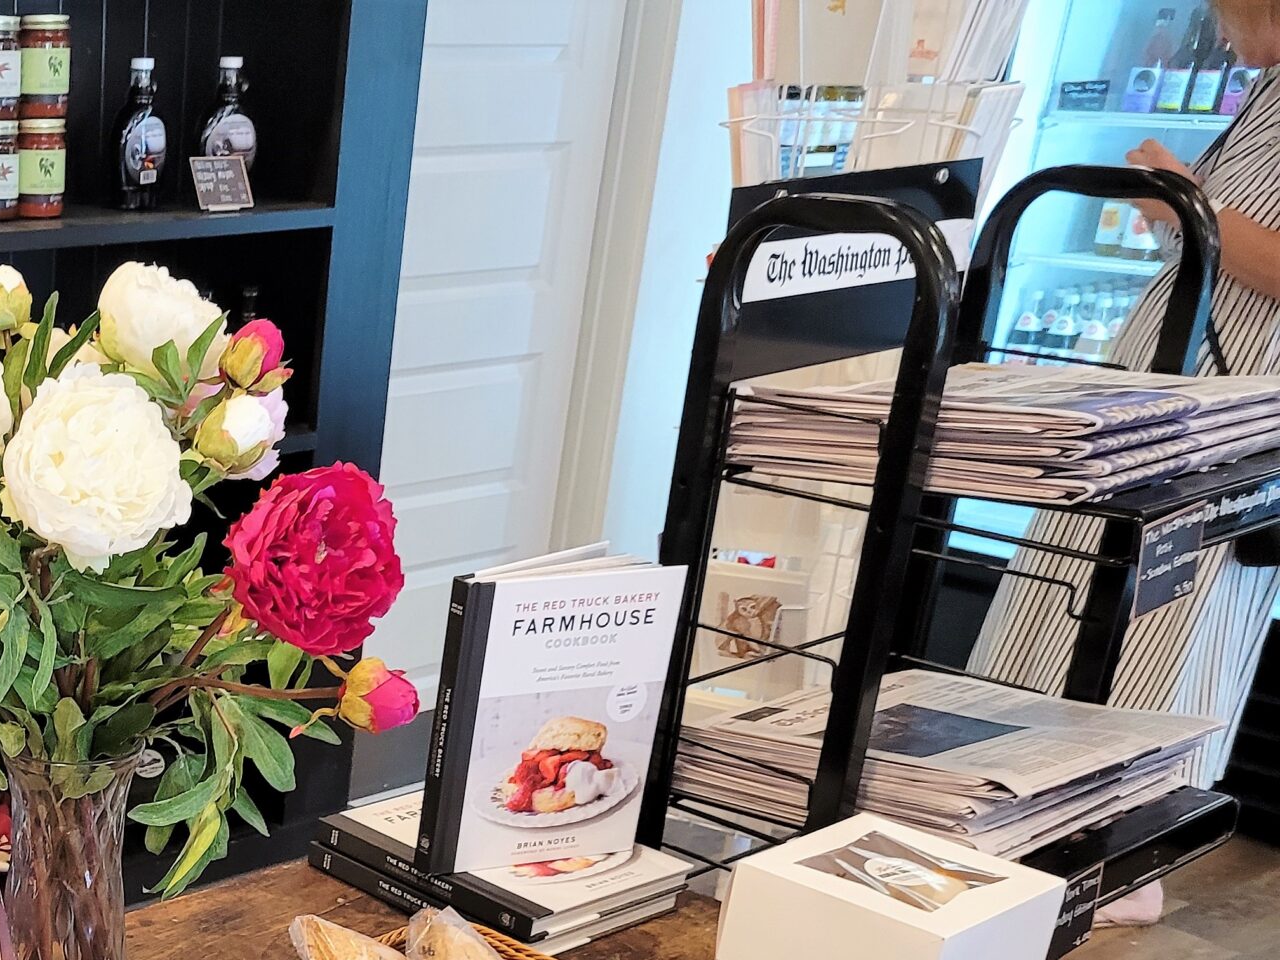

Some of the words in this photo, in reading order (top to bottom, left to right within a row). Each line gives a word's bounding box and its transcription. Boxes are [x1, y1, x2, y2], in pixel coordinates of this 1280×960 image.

[766, 251, 796, 288] The
[801, 242, 892, 281] Washington
[515, 602, 539, 613] THE
[542, 600, 567, 610] RED
[571, 597, 610, 608] TRUCK
[614, 592, 661, 605] BAKERY
[512, 608, 657, 636] FARMHOUSE
[545, 633, 618, 649] COOKBOOK
[516, 840, 544, 850] BRIAN
[547, 836, 576, 846] NOYES
[386, 855, 397, 866] THE
[398, 861, 410, 871] RED
[379, 880, 391, 891] THE
[390, 886, 403, 896] RED
[403, 892, 422, 906] TRUCK
